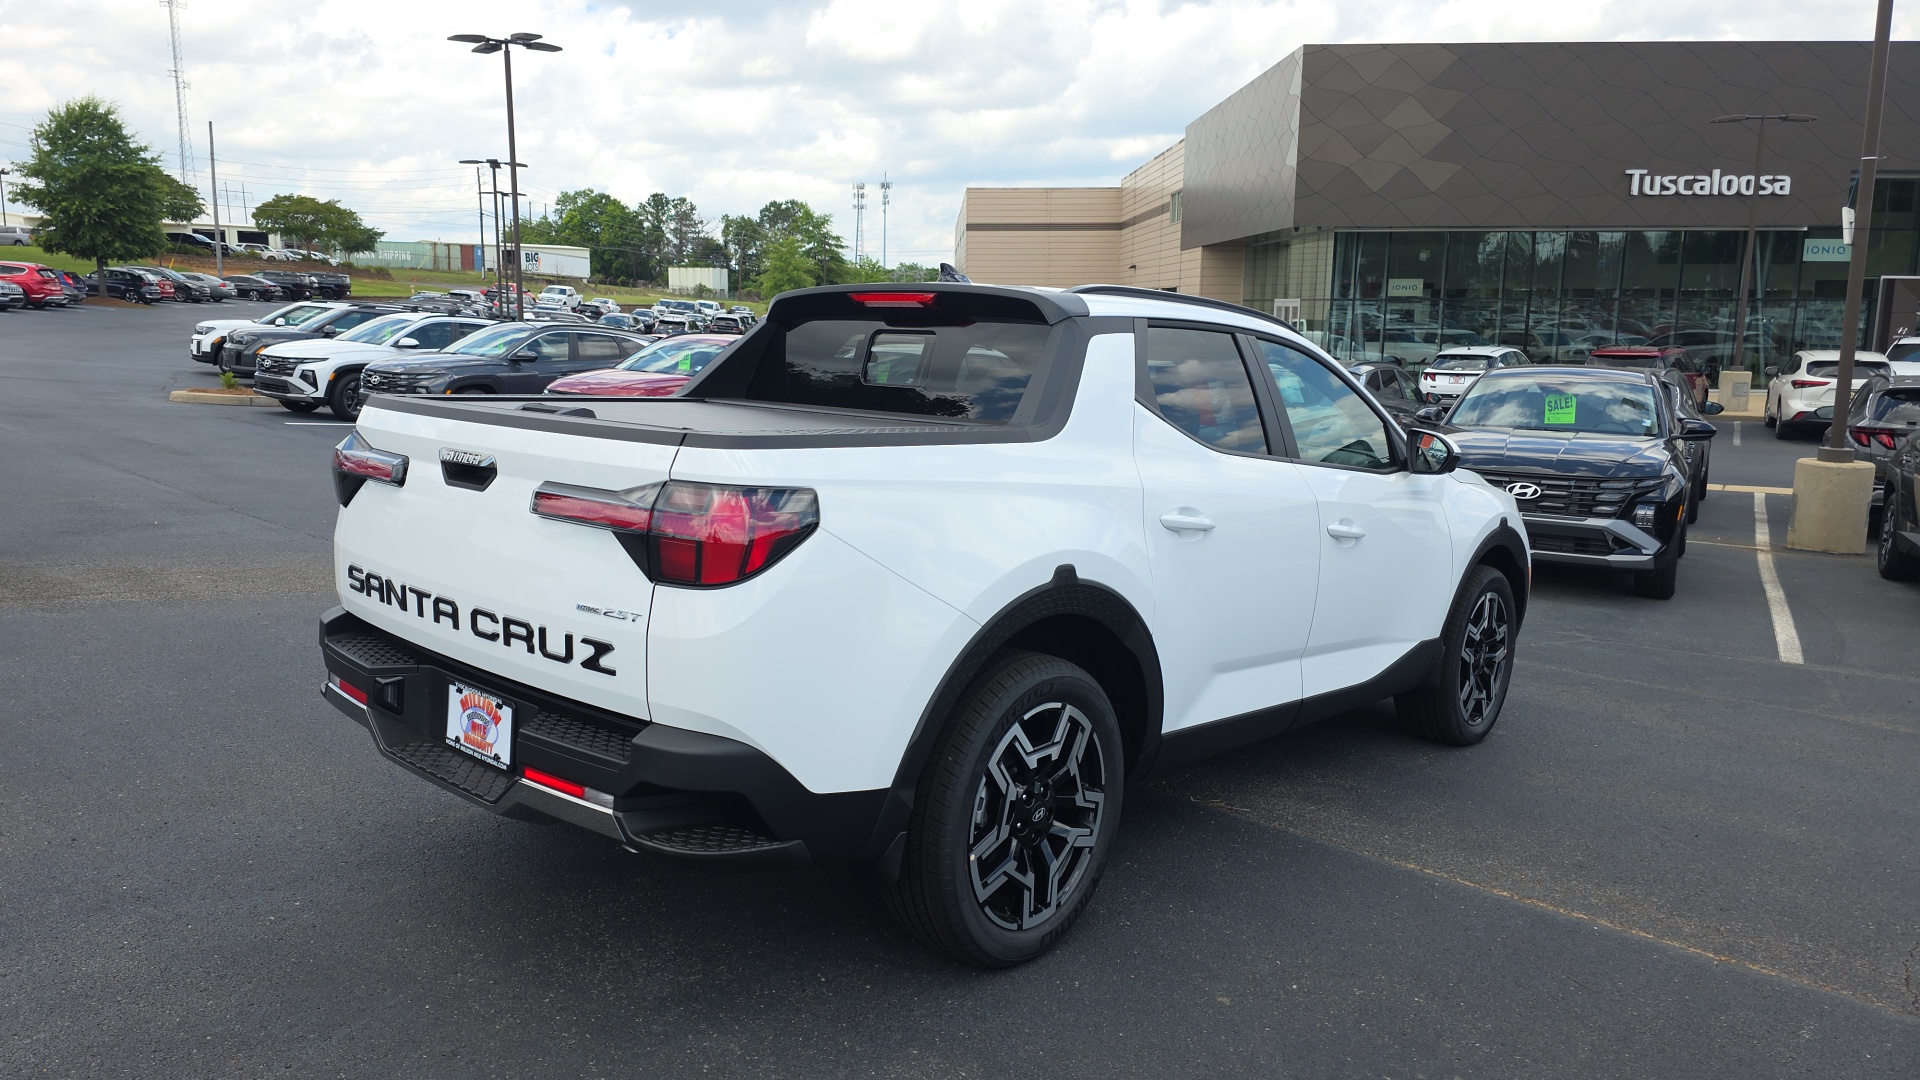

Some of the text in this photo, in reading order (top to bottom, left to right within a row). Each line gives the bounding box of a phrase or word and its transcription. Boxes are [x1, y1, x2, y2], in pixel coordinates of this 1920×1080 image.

[1624, 168, 1792, 196] Tuscaloosa
[378, 250, 411, 260] SHIPPING
[524, 252, 540, 263] BIG
[1806, 245, 1846, 255] IONIQ
[1547, 396, 1573, 413] SALE!
[441, 449, 482, 465] HYUNDAI
[576, 603, 601, 616] HTRAC
[347, 562, 617, 676] SANTA CRUZ
[459, 692, 502, 727] MILLION
[471, 720, 487, 740] MILE
[463, 732, 494, 754] WARRANTY
